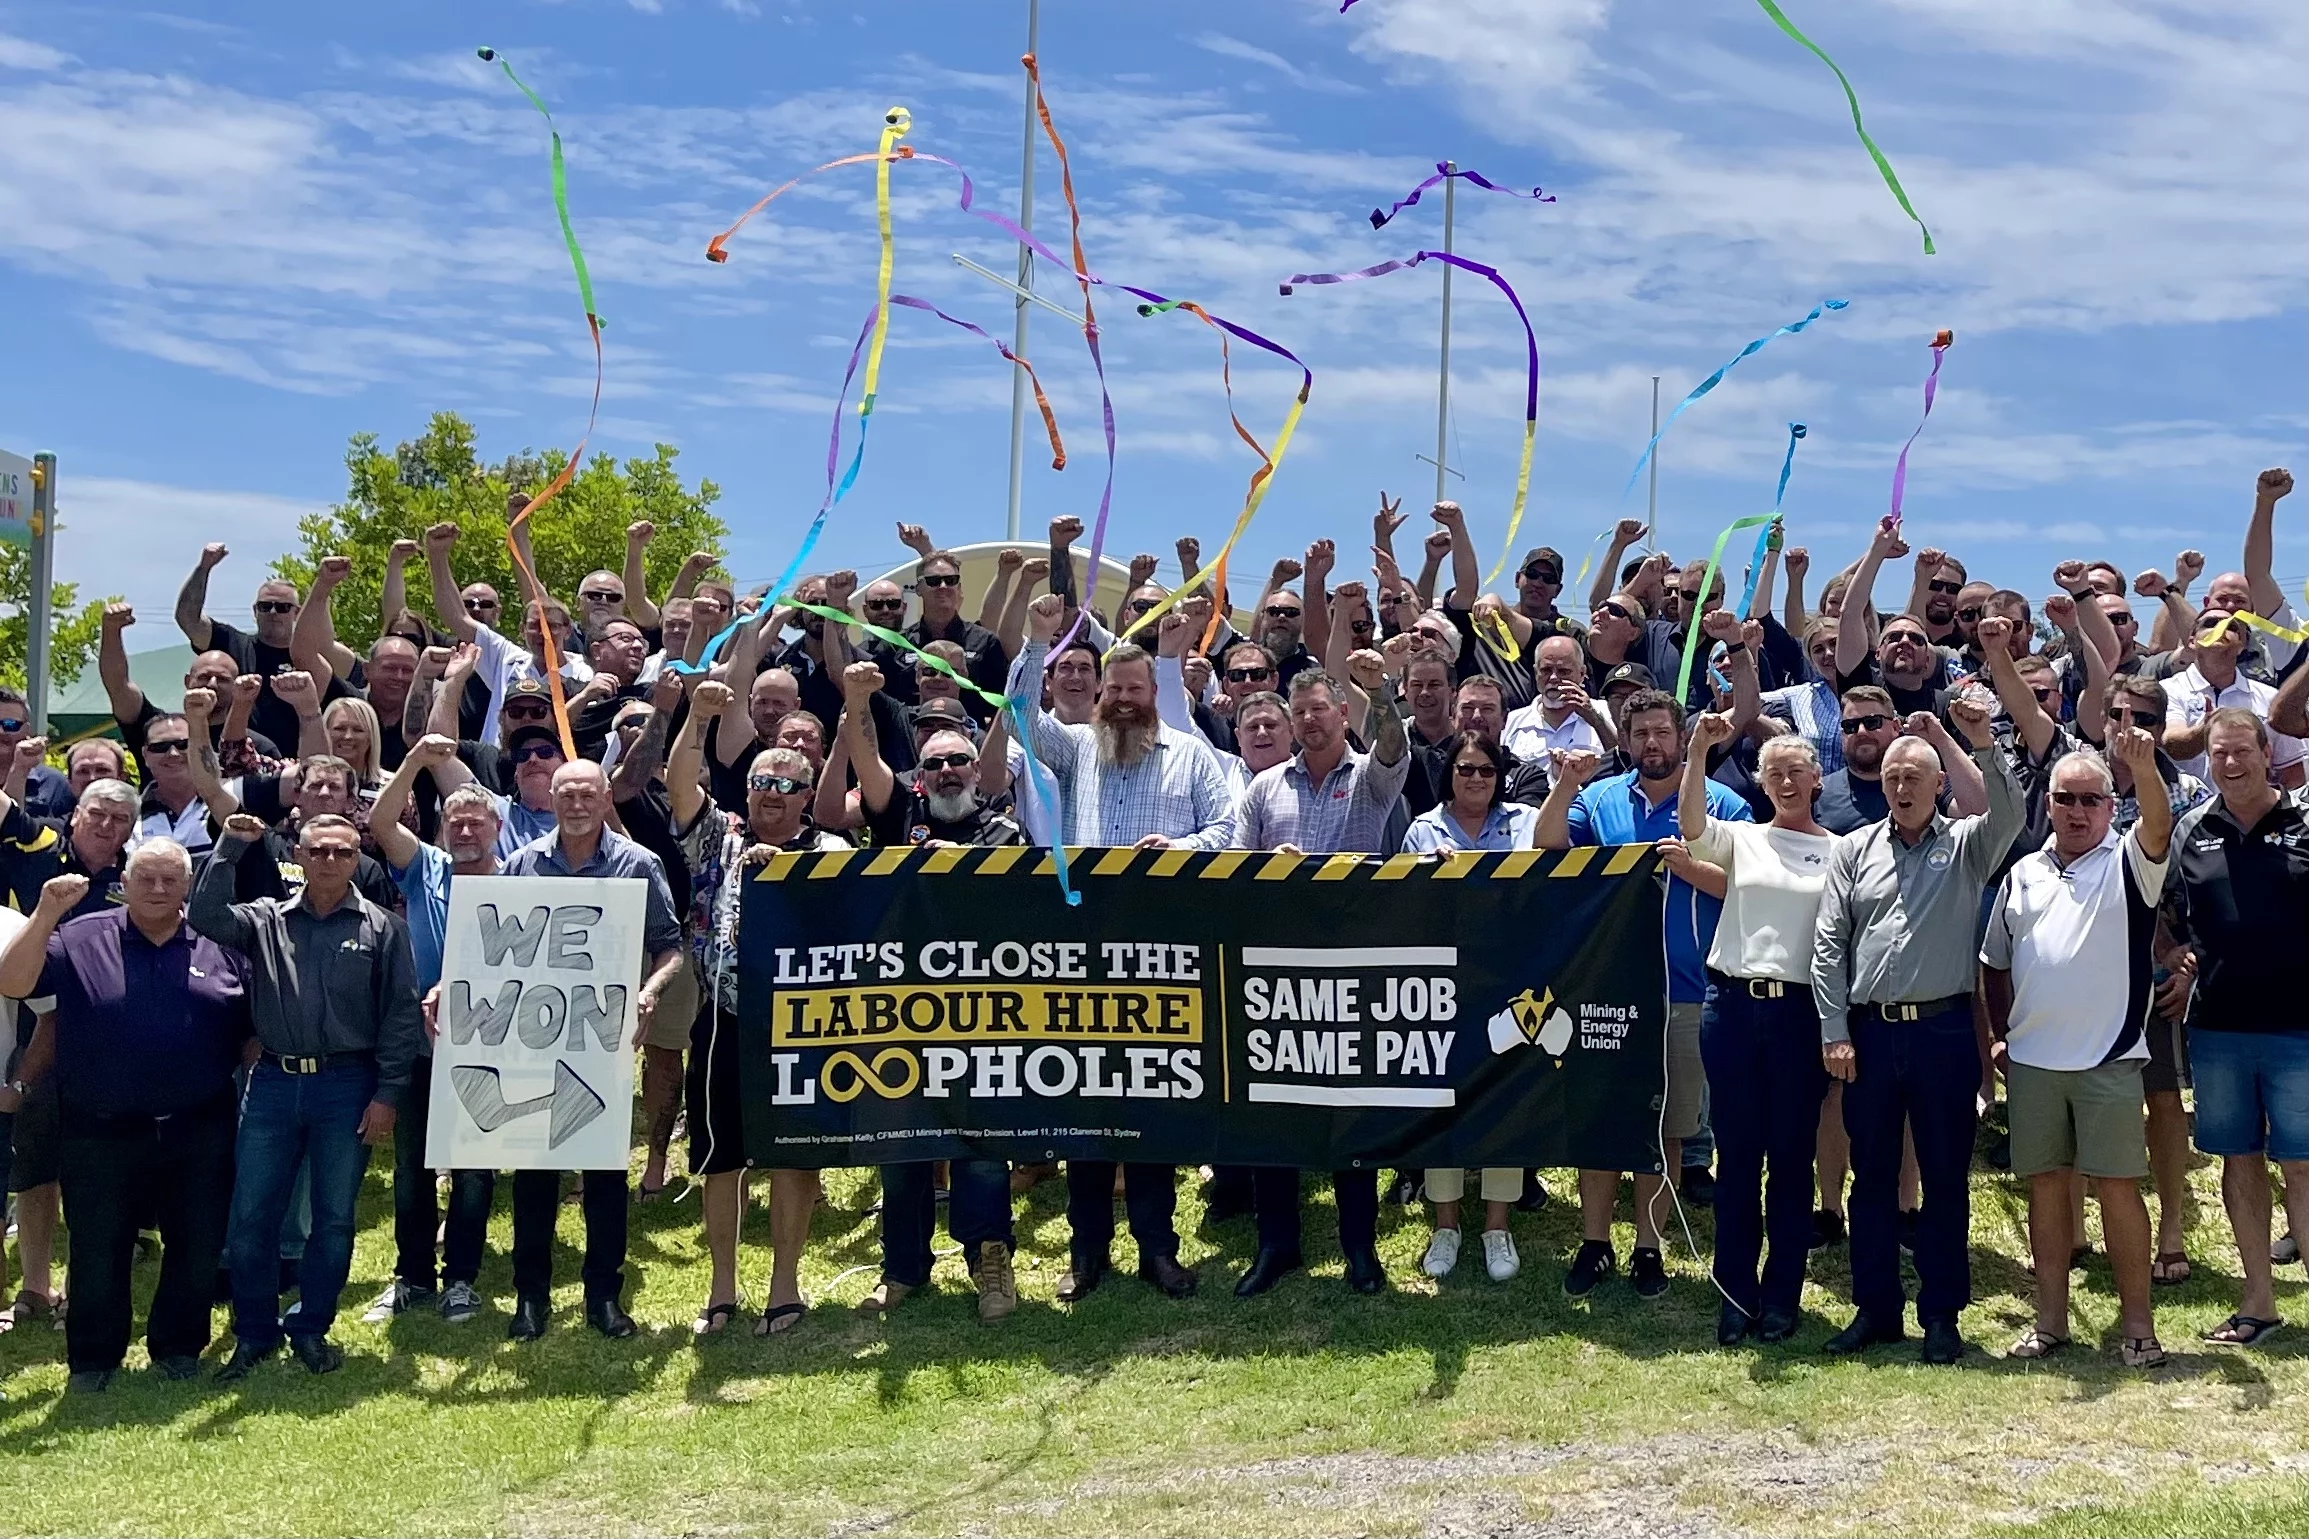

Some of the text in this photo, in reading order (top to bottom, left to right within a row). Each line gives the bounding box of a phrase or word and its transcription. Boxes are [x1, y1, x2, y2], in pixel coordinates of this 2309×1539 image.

[476, 903, 603, 970] WE
[772, 939, 1201, 983] LET'S CLOSE THE
[449, 979, 627, 1052] WON
[785, 991, 1191, 1039] LABOUR HIRE
[1243, 976, 1458, 1022] SAME JOB
[1579, 1003, 1639, 1022] Mining &
[1580, 1019, 1630, 1038] Energy
[1580, 1034, 1621, 1050] Union
[1247, 1029, 1456, 1076] SAME PAY
[812, 1135, 821, 1145] by
[876, 1131, 915, 1140] CFMMEU
[916, 1128, 942, 1138] Mining
[1017, 1128, 1039, 1136] Level
[1052, 1127, 1068, 1136] 215
[1113, 1128, 1142, 1139] Sydney
